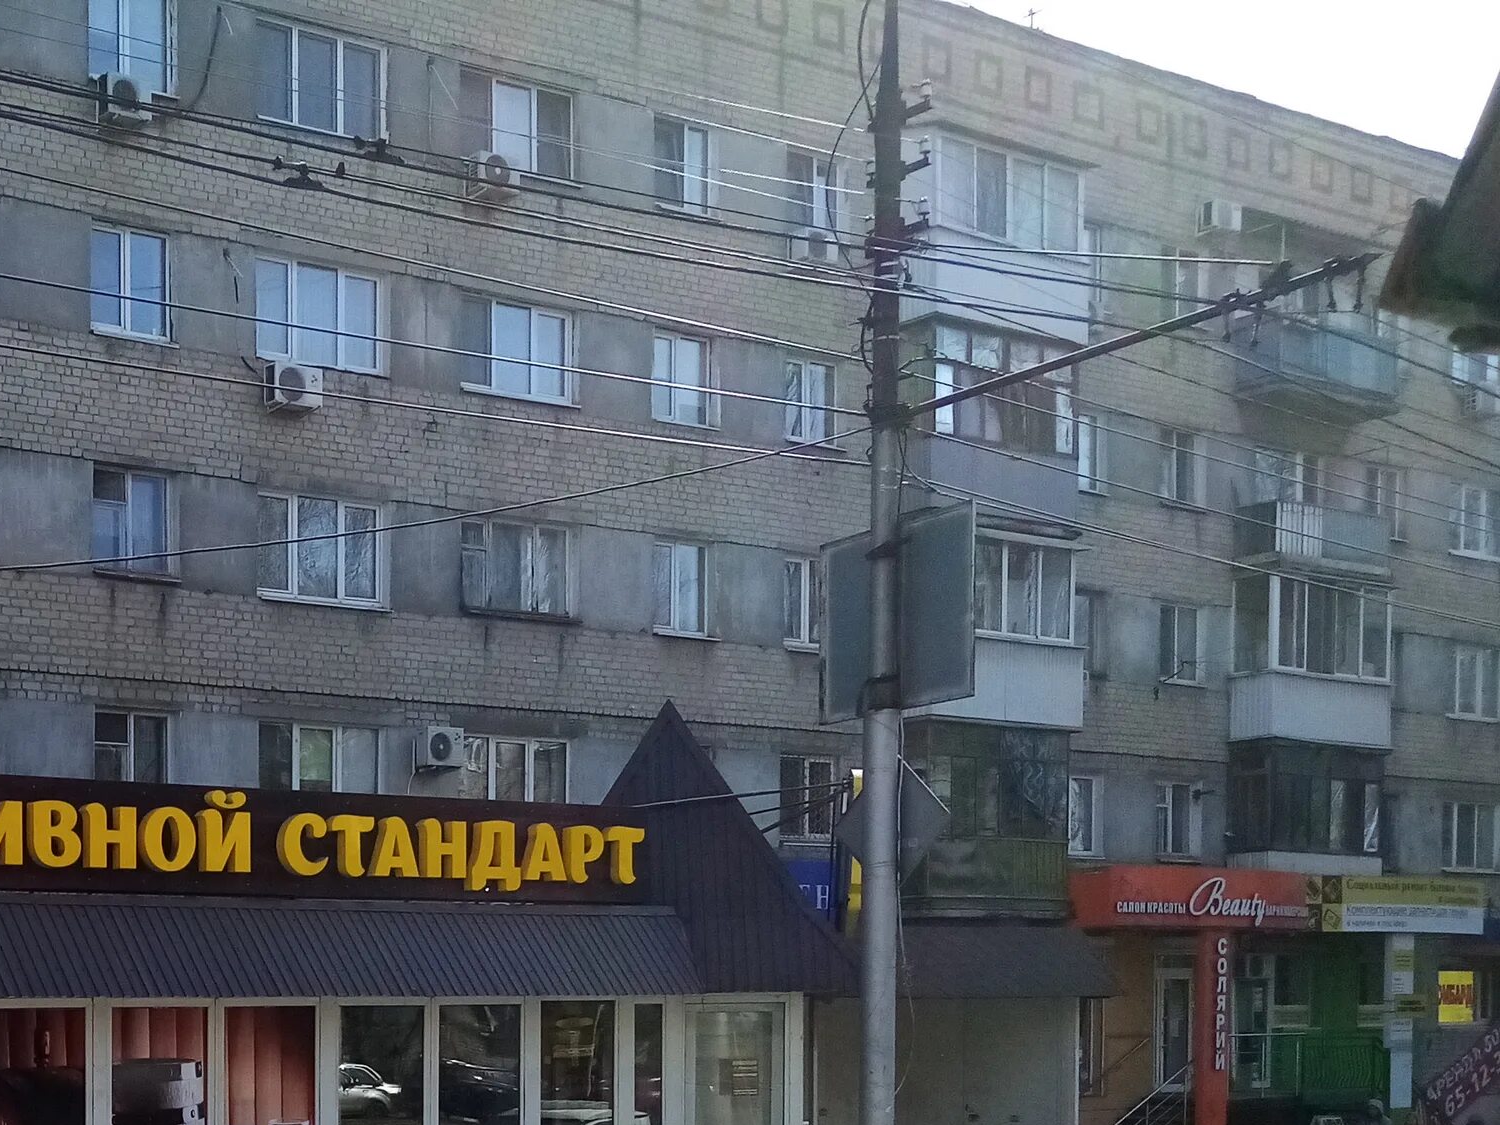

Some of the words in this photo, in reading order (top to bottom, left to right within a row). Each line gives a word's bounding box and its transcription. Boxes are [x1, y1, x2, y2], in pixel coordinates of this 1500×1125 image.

[276, 812, 646, 891] СТАНДАРТ
[1117, 901, 1146, 913] САЛОН
[1147, 902, 1186, 914] КРАСОТЫ
[1189, 877, 1265, 926] Beauty
[1215, 938, 1228, 1070] СОЛЯРИЙ
